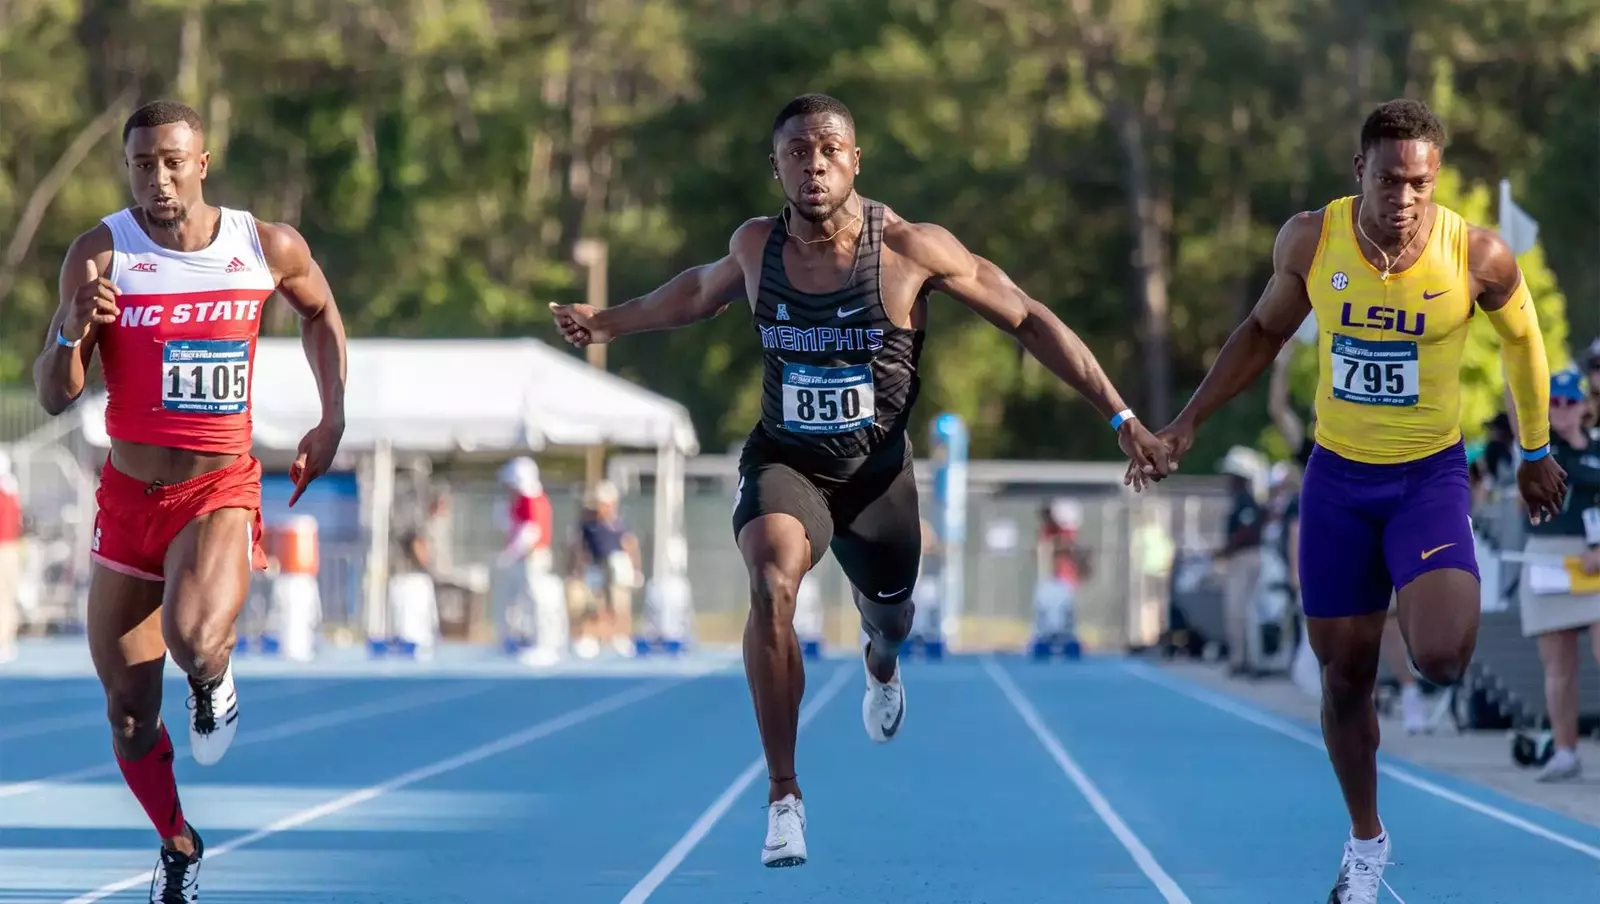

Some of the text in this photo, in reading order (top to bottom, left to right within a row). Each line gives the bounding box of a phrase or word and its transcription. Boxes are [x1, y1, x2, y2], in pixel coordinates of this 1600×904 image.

[128, 262, 157, 272] ACC
[121, 300, 260, 327] NC STATE
[1341, 302, 1426, 336] LSU
[758, 324, 884, 351] MEMPHIS
[167, 364, 246, 400] 1105
[1343, 359, 1404, 394] 795
[797, 388, 860, 421] 850
